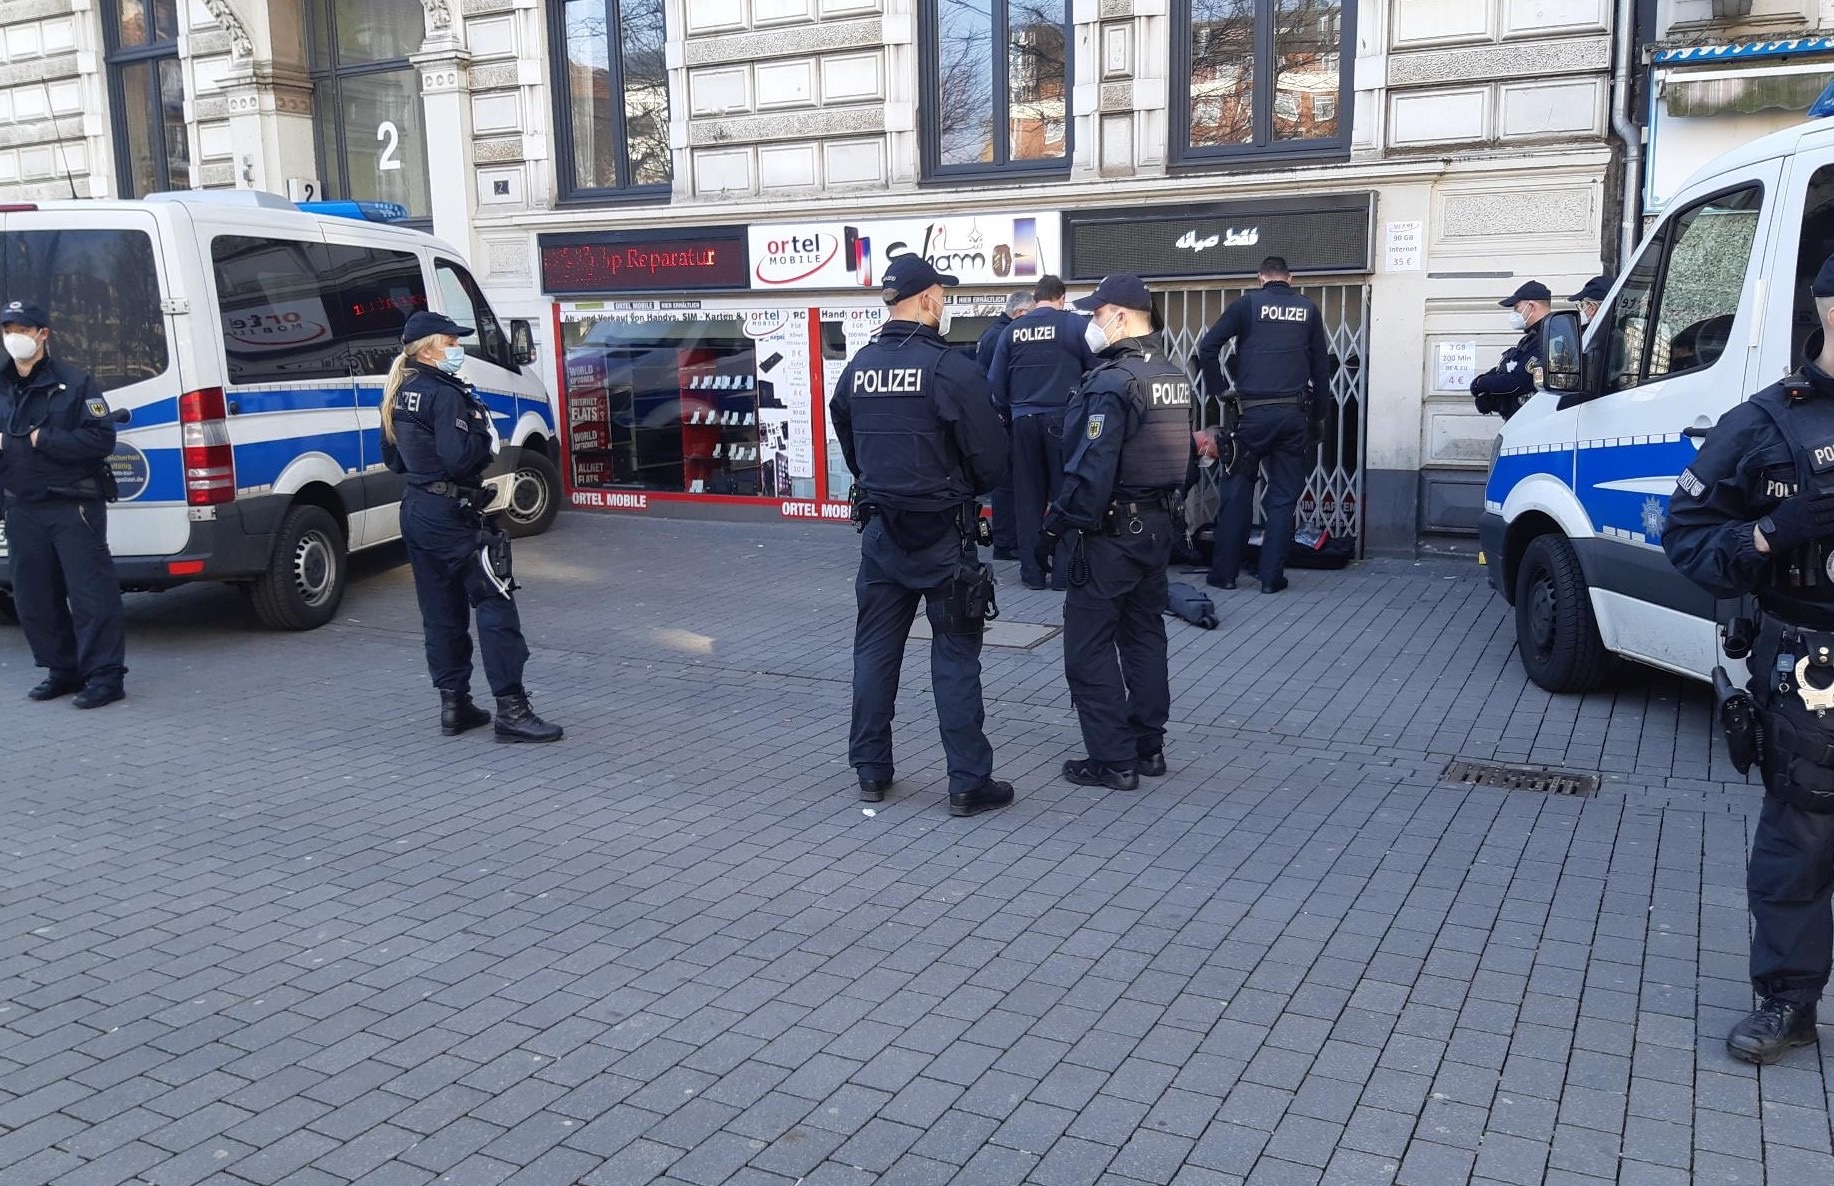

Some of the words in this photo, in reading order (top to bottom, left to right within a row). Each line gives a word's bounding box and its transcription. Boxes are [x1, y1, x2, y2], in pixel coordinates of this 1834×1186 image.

[377, 121, 400, 171] 2
[304, 184, 314, 202] 2
[767, 233, 820, 255] ortel
[626, 247, 715, 274] Reparatur
[769, 254, 821, 266] MOBILE
[682, 312, 698, 321] SIM
[705, 312, 734, 321] Karten
[751, 310, 780, 320] ortel
[851, 308, 881, 319] ortel
[1260, 305, 1307, 322] POLIZEI
[1013, 326, 1056, 343] POLIZEI
[569, 364, 594, 375] WORLD
[853, 368, 922, 393] POLIZEI
[1151, 383, 1191, 405] POLIZE
[571, 406, 598, 421] FLATS
[573, 430, 598, 442] WORLD
[578, 463, 604, 474] ALLNET
[572, 492, 604, 505] ORTEL
[606, 494, 647, 508] MOBILE
[781, 502, 818, 517] ORTEL
[821, 504, 851, 519] MOBI
